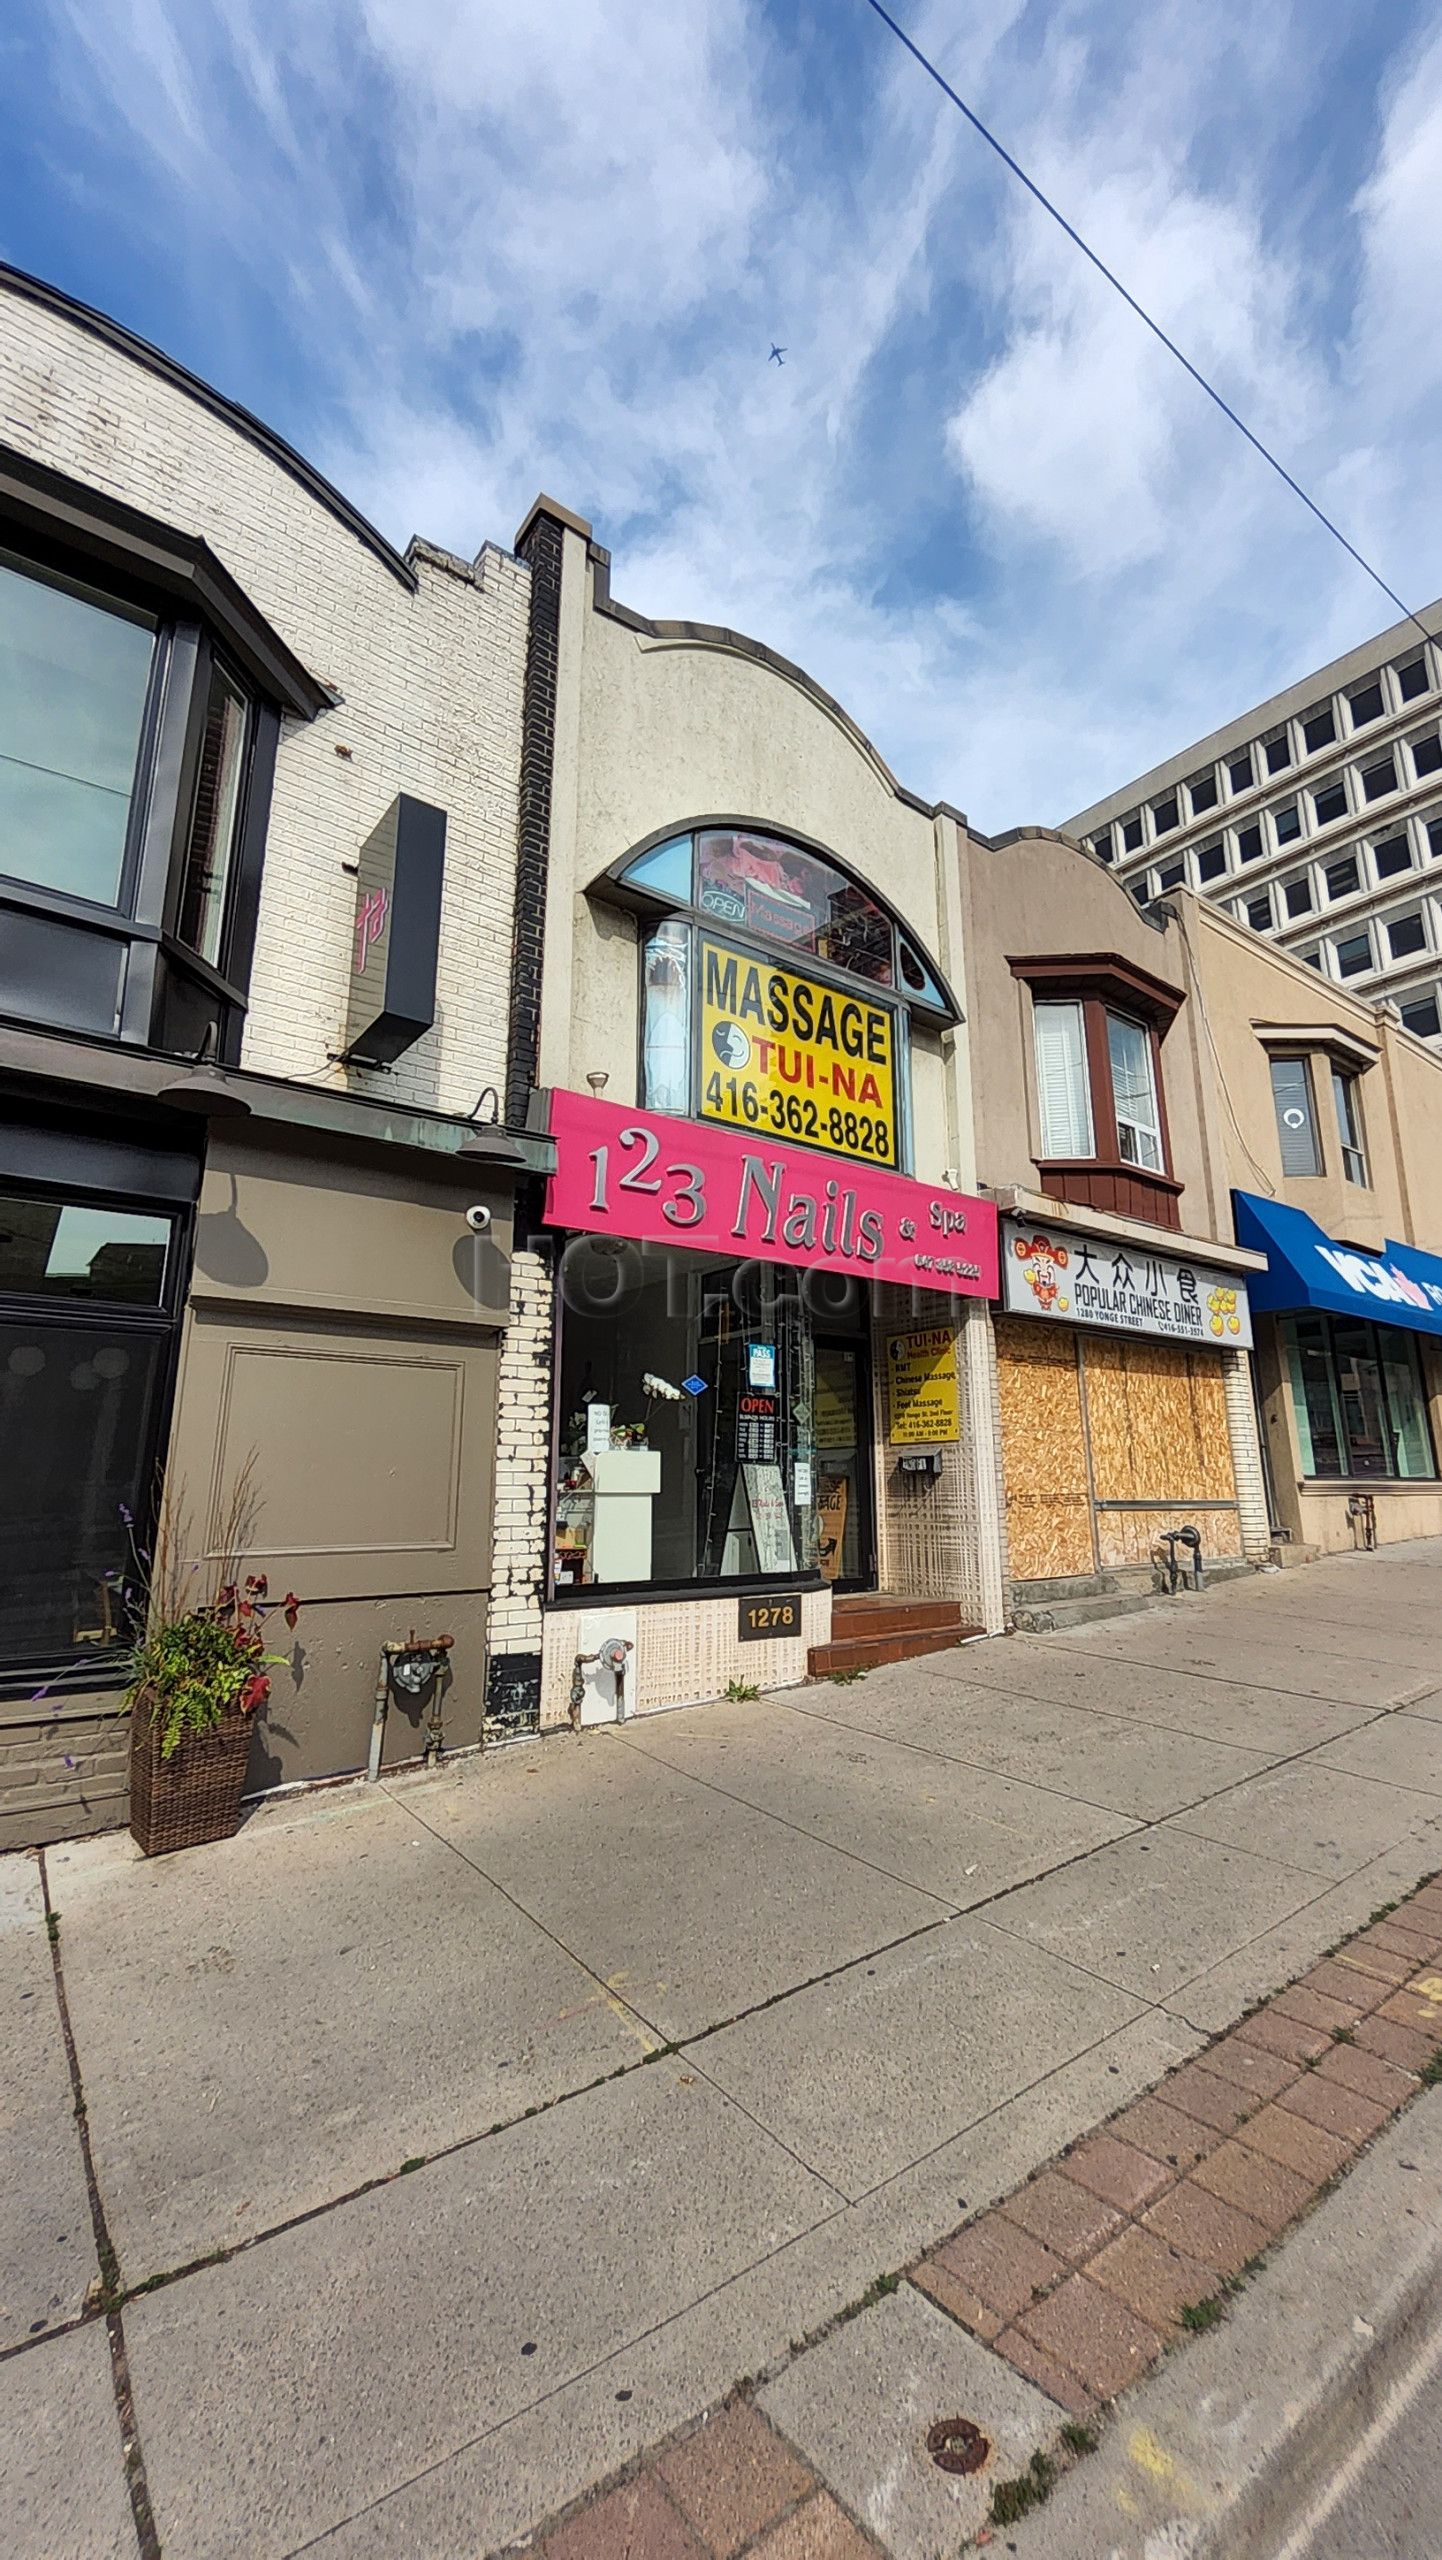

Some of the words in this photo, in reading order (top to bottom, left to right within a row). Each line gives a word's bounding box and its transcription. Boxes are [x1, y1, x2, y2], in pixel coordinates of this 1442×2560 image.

[702, 893, 746, 919] OPEN
[706, 949, 887, 1066] MASSAGE
[751, 1035, 883, 1109] TUI-NA
[706, 1070, 890, 1158] 416-362-8828
[588, 1127, 706, 1227] 123
[730, 1154, 885, 1261] Nails
[899, 1216, 916, 1240] &
[929, 1200, 966, 1237] Spa
[1074, 1244, 1199, 1305] 大众小食
[1074, 1282, 1127, 1313] POPULAR
[1129, 1293, 1172, 1322] CHINESE
[1174, 1302, 1203, 1327] DINER
[1076, 1307, 1094, 1319] 1280
[1095, 1310, 1119, 1323] YONGE
[1119, 1314, 1143, 1327] STREET
[753, 1348, 771, 1359] PASS
[896, 1375, 922, 1385] Chinese
[924, 1371, 956, 1381] Massage
[741, 1397, 775, 1414] OPEN
[896, 1401, 911, 1409] Foot
[912, 1399, 943, 1408] Massage
[748, 1606, 793, 1628] 1278
